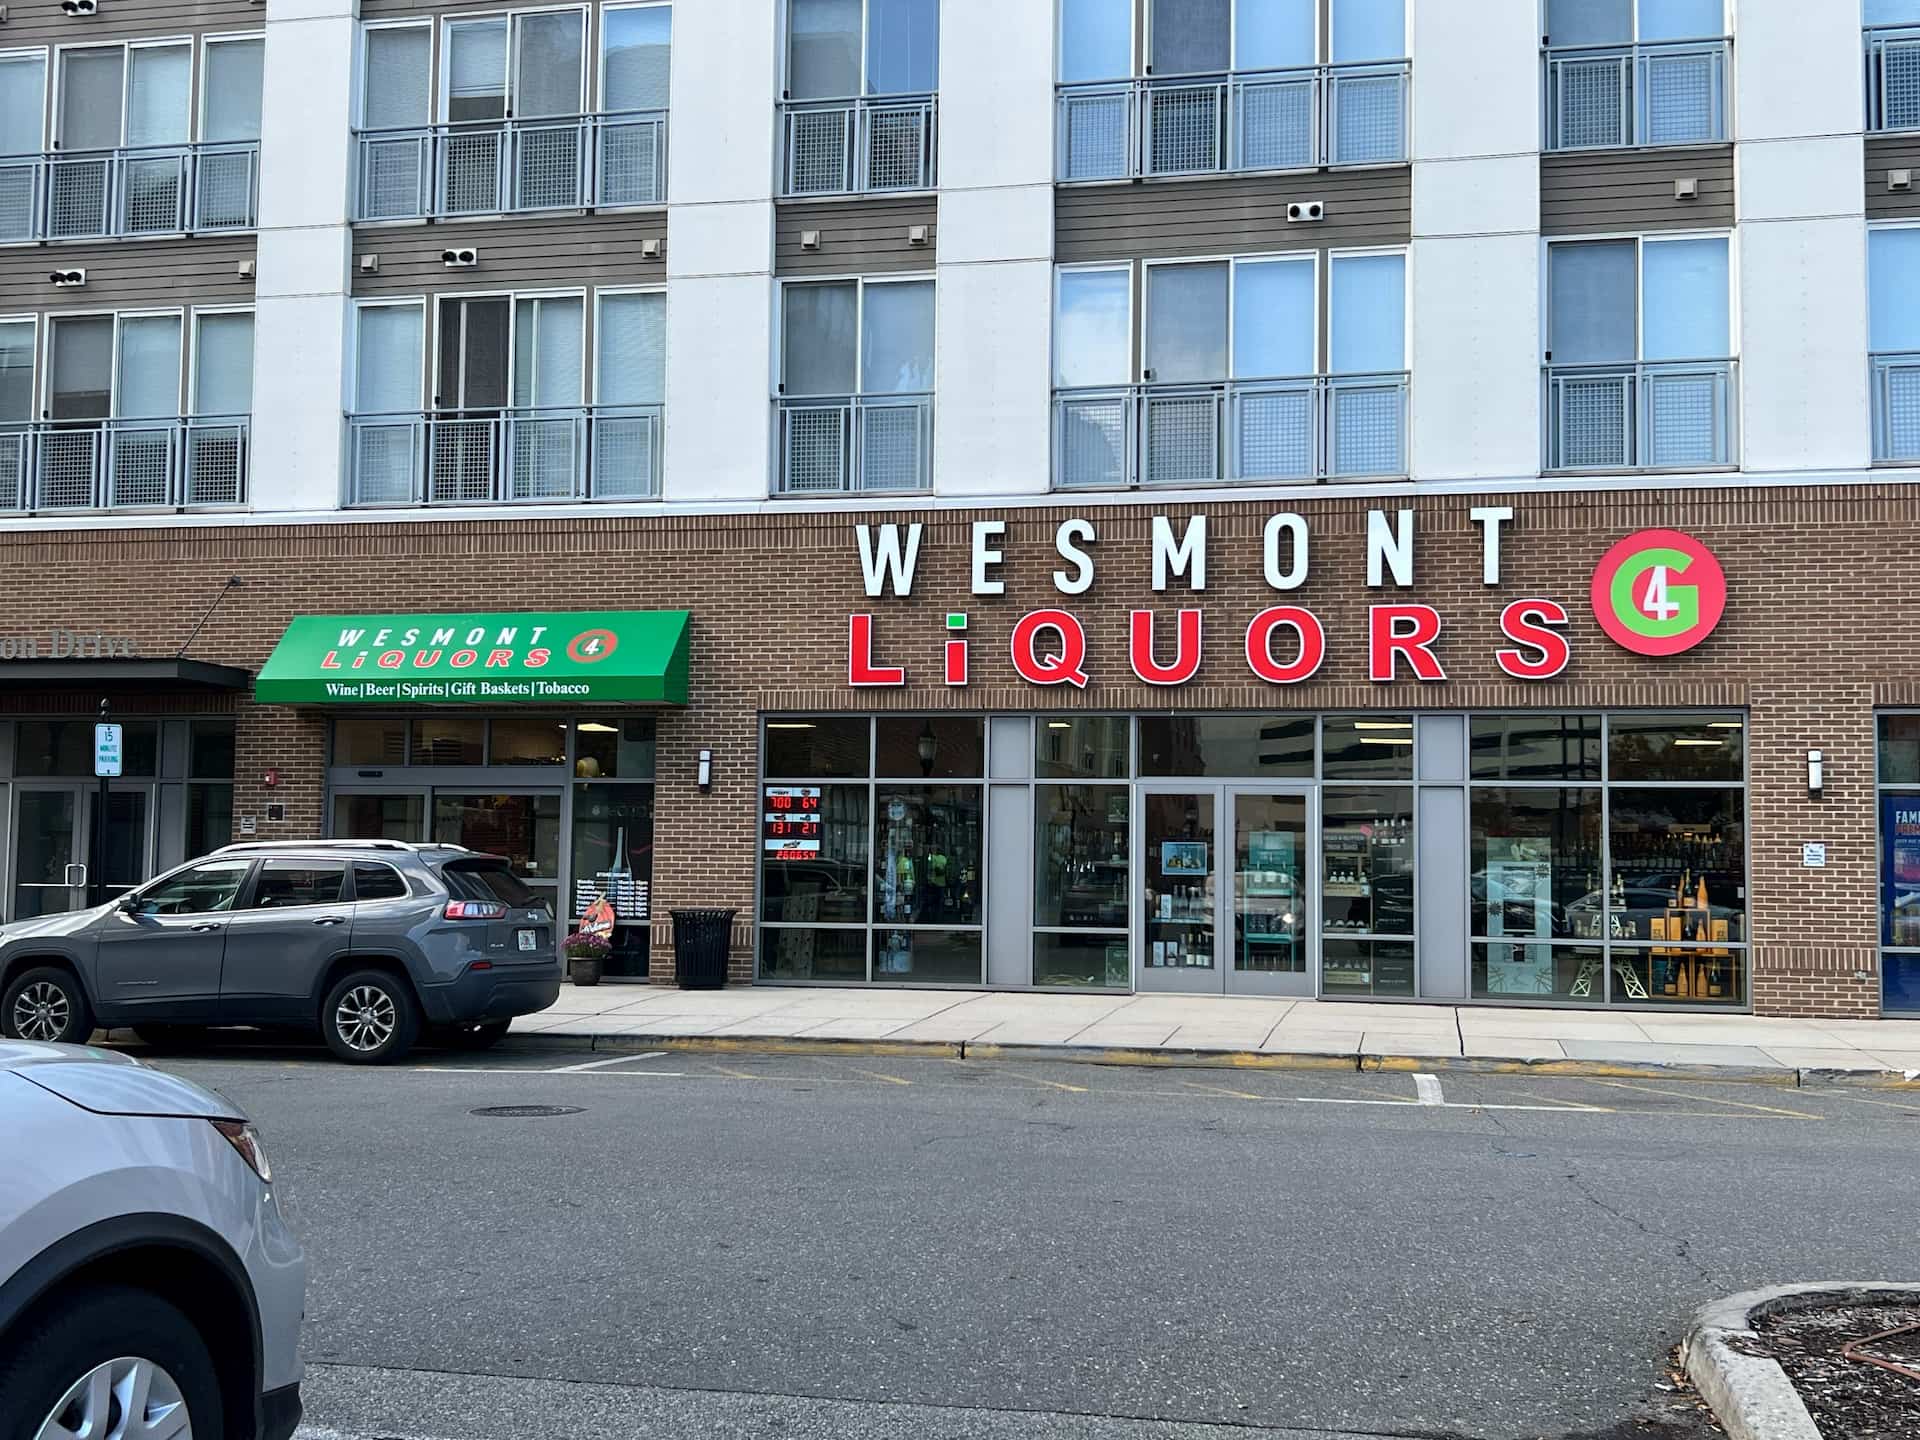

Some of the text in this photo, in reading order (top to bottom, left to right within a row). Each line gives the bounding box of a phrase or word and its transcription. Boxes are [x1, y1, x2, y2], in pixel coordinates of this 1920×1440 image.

[855, 506, 1514, 597] WESMONT
[49, 627, 138, 659] Drive
[336, 627, 547, 647] WESMONT
[104, 730, 114, 742] 15
